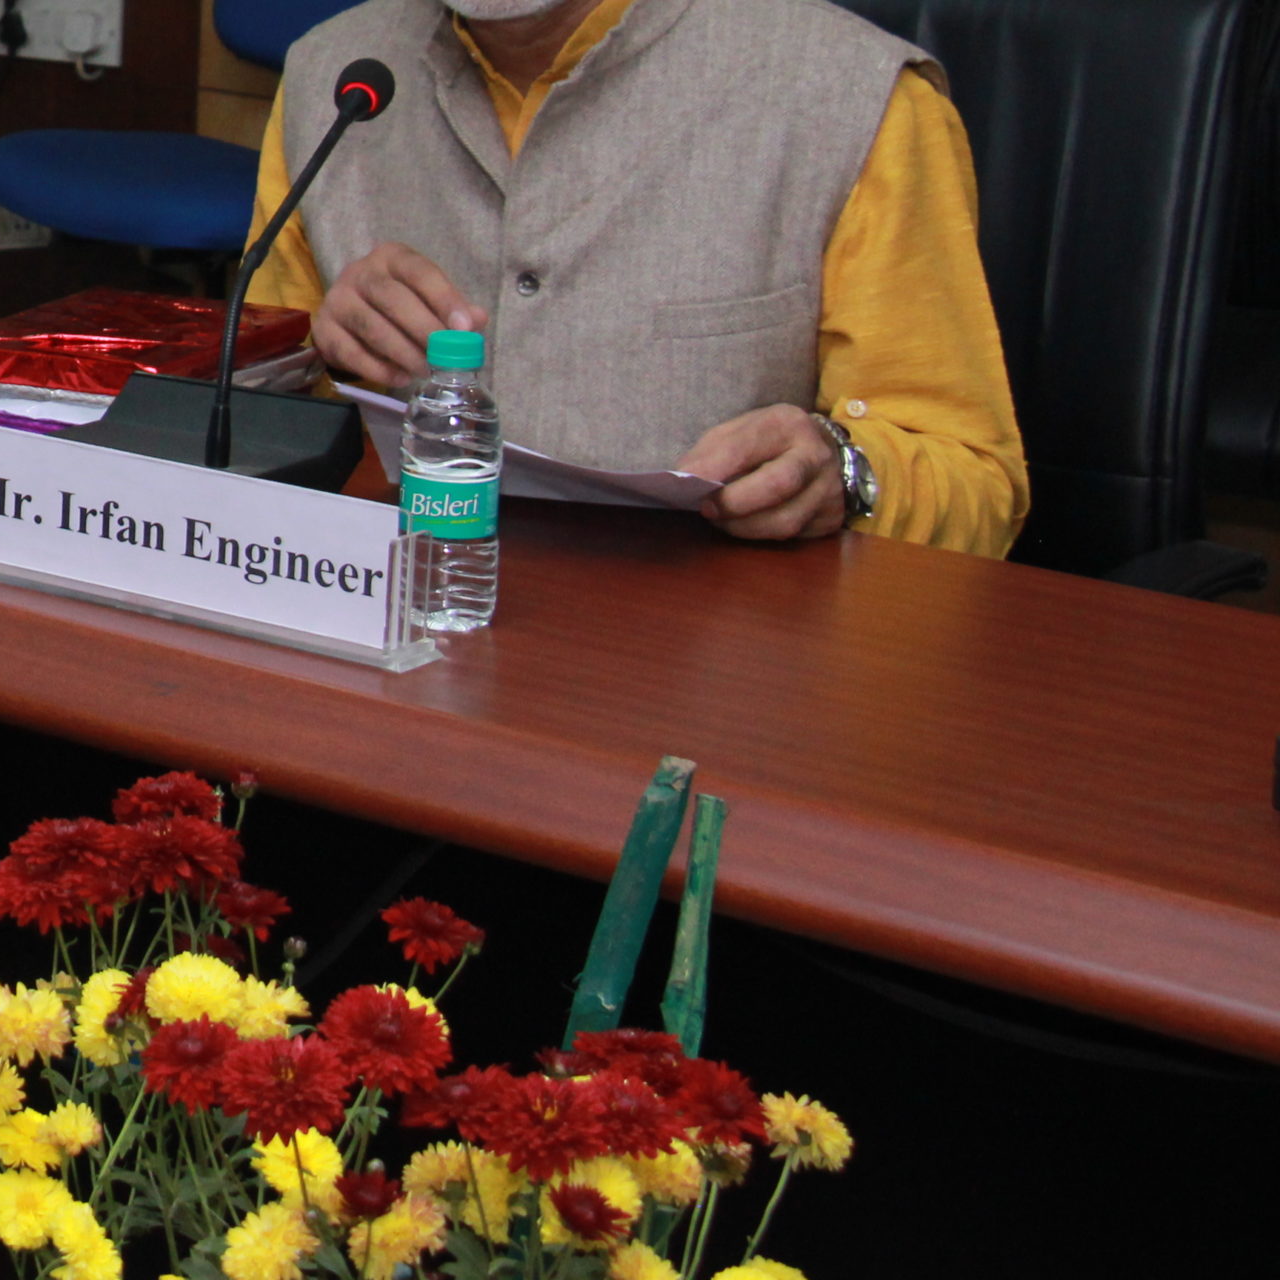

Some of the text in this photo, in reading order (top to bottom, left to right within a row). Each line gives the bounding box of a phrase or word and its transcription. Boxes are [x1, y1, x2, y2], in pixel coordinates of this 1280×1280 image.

[411, 493, 479, 517] Bisleri
[56, 489, 166, 552] Irfan
[180, 516, 384, 598] Engineer
